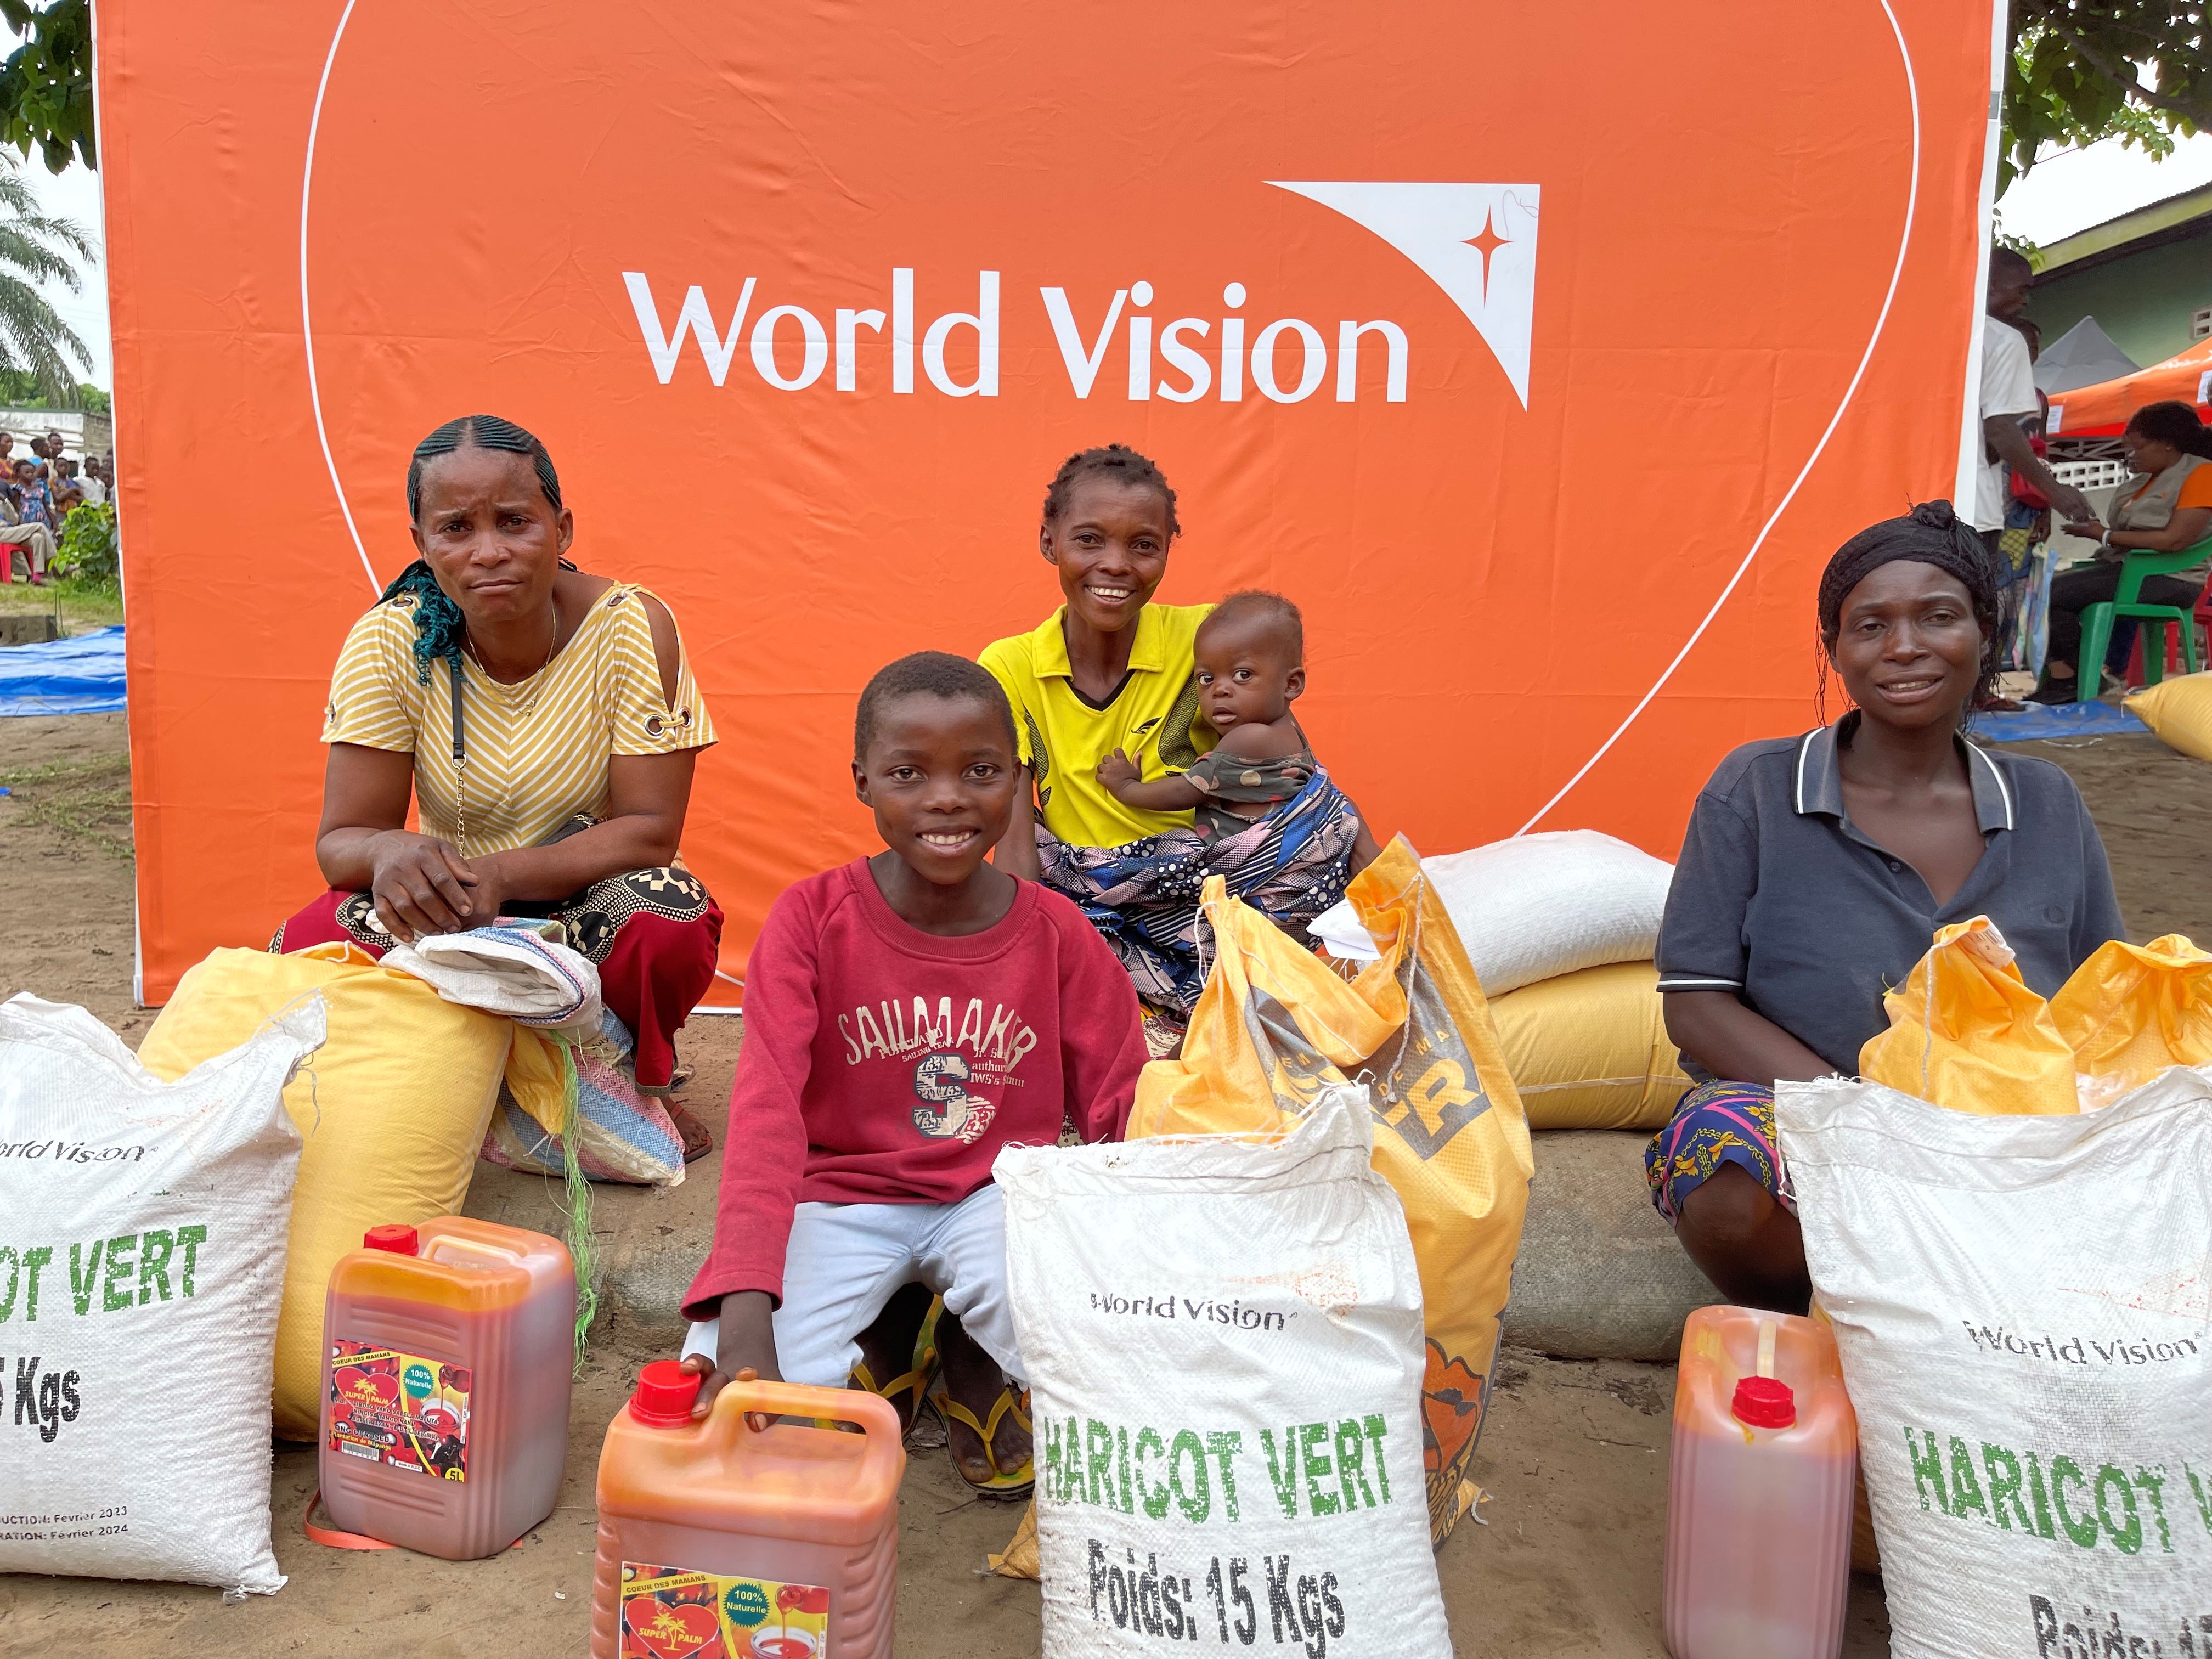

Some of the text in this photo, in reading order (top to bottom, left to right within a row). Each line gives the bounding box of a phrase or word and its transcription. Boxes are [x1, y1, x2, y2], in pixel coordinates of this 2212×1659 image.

[622, 268, 1408, 404] World Vision
[902, 1045, 932, 1062] SAILING
[70, 1224, 207, 1316] VERT
[1090, 1292, 1285, 1330] World Vision
[1962, 1319, 2088, 1365] World
[366, 1351, 391, 1359] MAMANS
[410, 1369, 430, 1380] 100%
[405, 1378, 432, 1390] Naturelle
[15, 1356, 81, 1443] Kgs
[344, 1391, 388, 1406] SUPER PALM
[335, 1425, 351, 1434] ONG
[1044, 1413, 1393, 1525] HARICOT VERT
[1903, 1426, 2175, 1555] HARICOT
[99, 1506, 128, 1519] 2023
[99, 1524, 128, 1536] 2024
[626, 1575, 706, 1593] COEUR DES MAMANS
[734, 1590, 763, 1602] 100%
[1088, 1538, 1345, 1659] Poids: 15 Kgs
[726, 1601, 767, 1614] Naturelle
[638, 1627, 703, 1645] SUPER PALM
